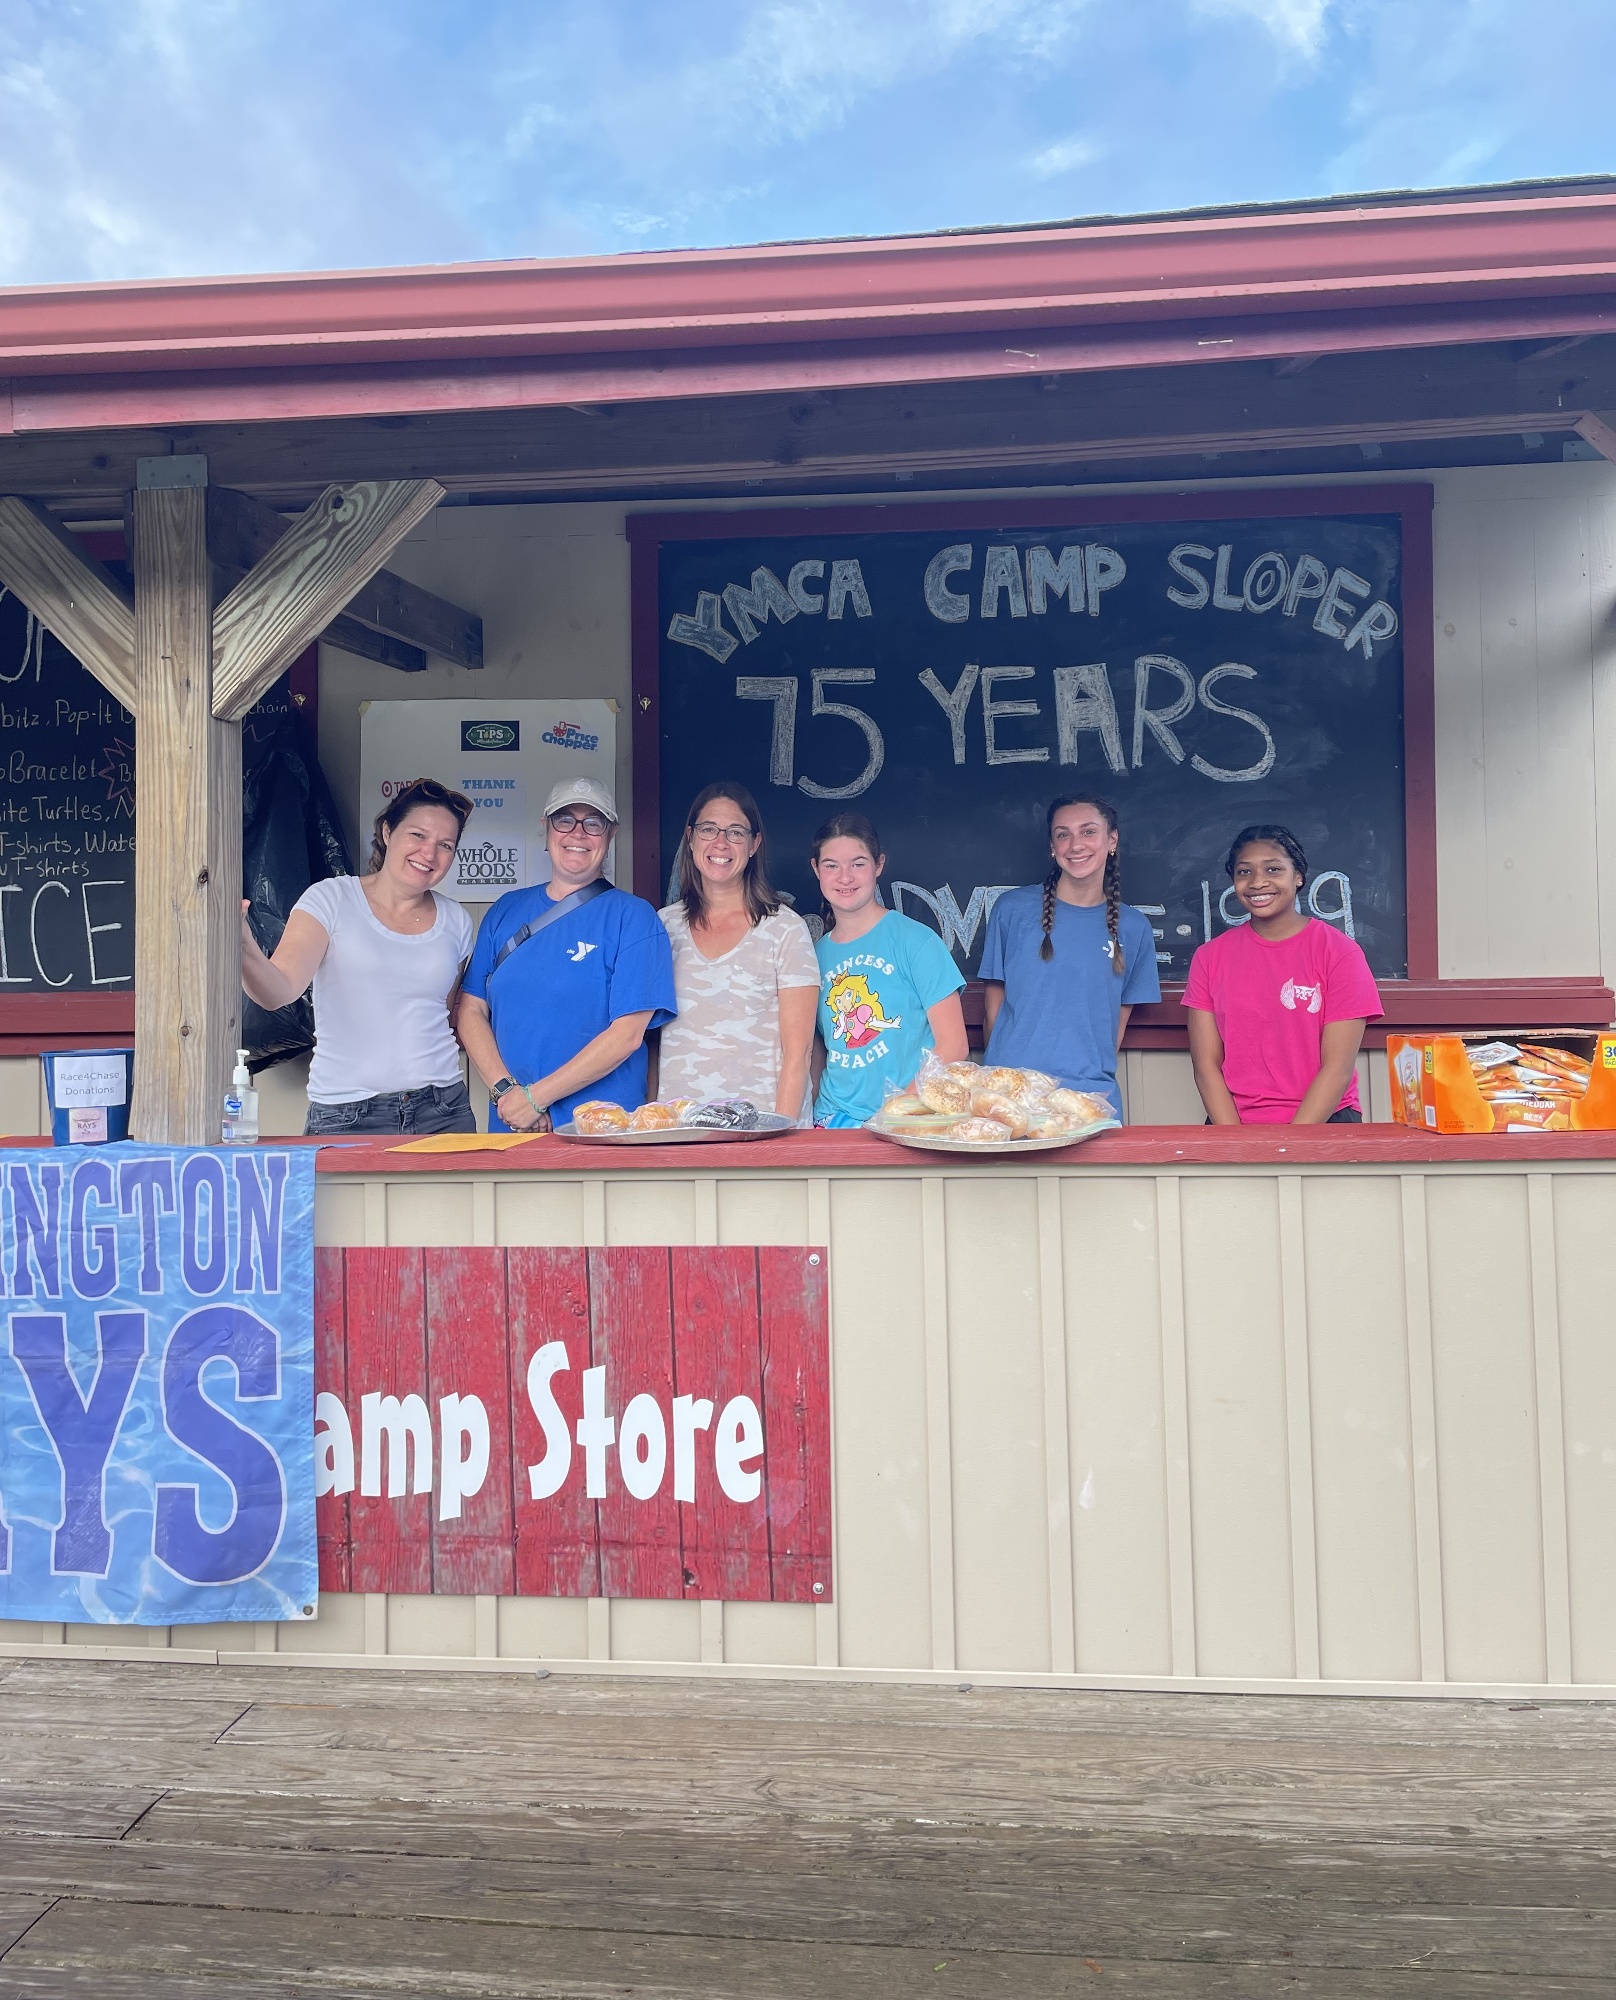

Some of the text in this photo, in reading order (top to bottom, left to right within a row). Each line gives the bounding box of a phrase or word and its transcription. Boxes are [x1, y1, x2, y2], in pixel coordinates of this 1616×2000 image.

[666, 543, 1398, 664] YMCA CAMP SLOPER
[565, 727, 600, 743] Price
[735, 653, 1276, 799] 75 YEARS
[541, 731, 599, 751] Chopper
[10, 750, 97, 784] Bracelet
[461, 779, 516, 790] THANK
[32, 796, 110, 822] Turtles,
[473, 798, 504, 808] YOU
[457, 842, 518, 863] WHOLE
[10, 857, 90, 878] T-shirts
[458, 863, 516, 878] FOODS
[829, 1040, 890, 1069] PEACH
[60, 1071, 120, 1082] Race4Chase
[65, 1086, 115, 1096] Donations
[77, 1121, 98, 1130] RAYS
[0, 1152, 290, 1300] NGTON
[315, 1341, 766, 1521] amp Store
[0, 1303, 287, 1587] YS
